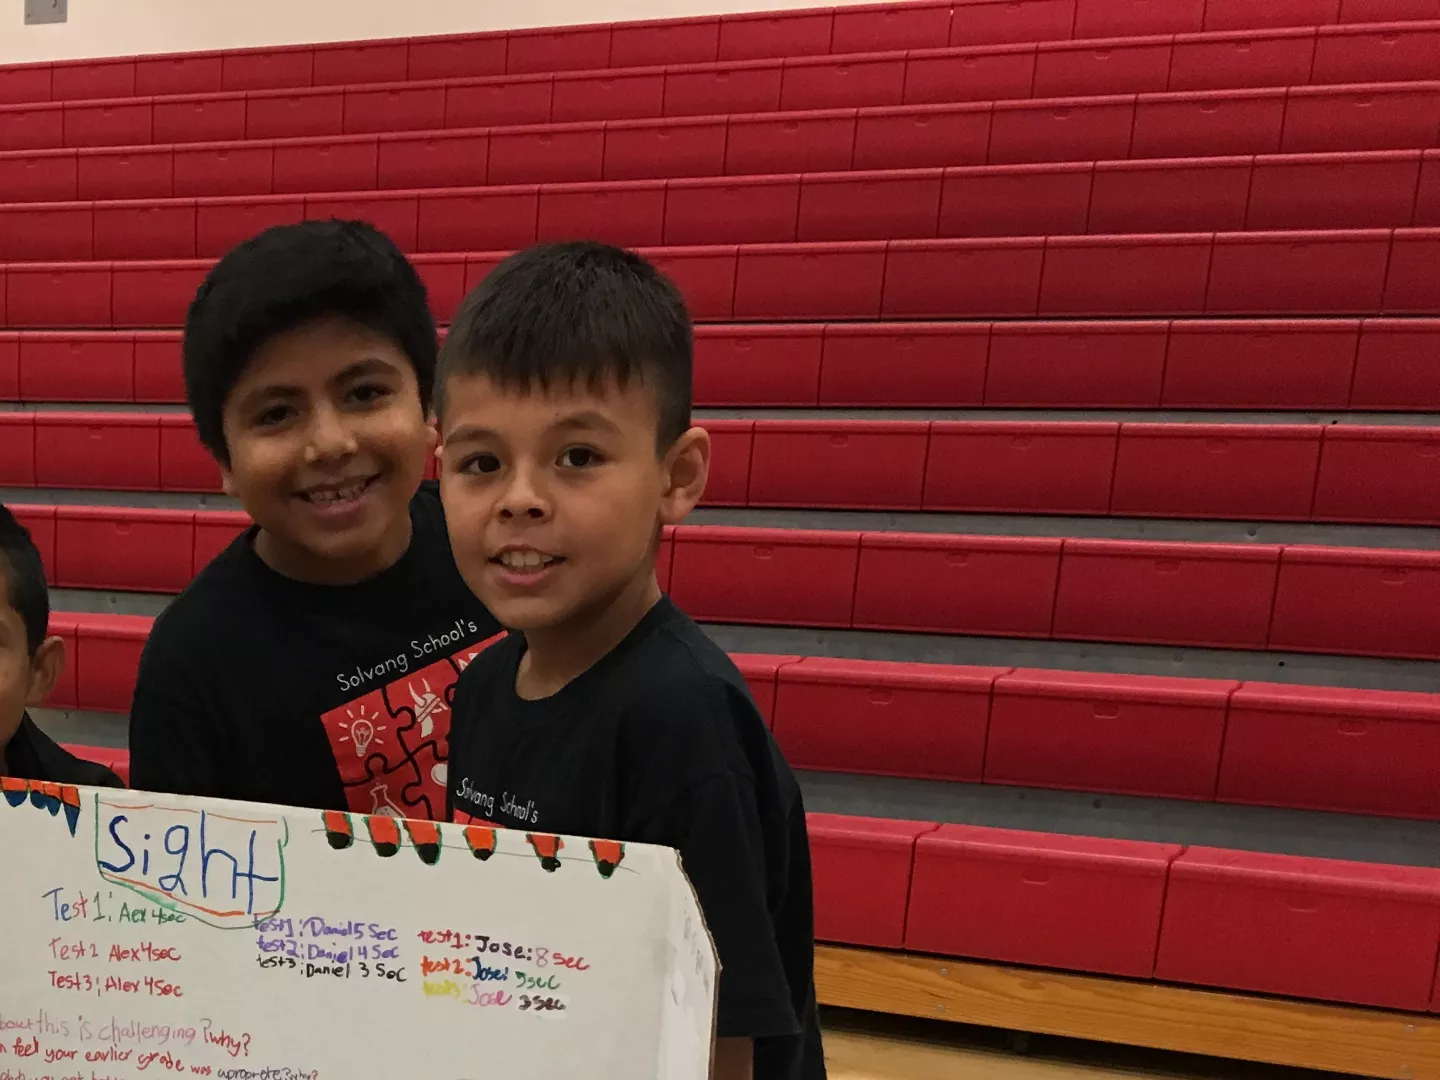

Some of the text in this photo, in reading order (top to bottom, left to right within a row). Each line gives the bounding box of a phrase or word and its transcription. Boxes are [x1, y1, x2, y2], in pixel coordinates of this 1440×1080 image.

[336, 618, 478, 692] Solvang School's
[456, 777, 540, 824] Solvang School's
[99, 810, 279, 915] Sight
[109, 944, 139, 961] Alex
[308, 942, 353, 963] Daniel
[536, 947, 548, 968] 8
[306, 962, 369, 978] Daniel 3
[105, 976, 140, 993] Alex
[36, 1008, 70, 1037] this
[78, 1015, 92, 1041] is
[98, 1015, 196, 1045] challenging
[12, 1036, 39, 1057] feel
[45, 1049, 77, 1063] your
[85, 1044, 133, 1062] earlier
